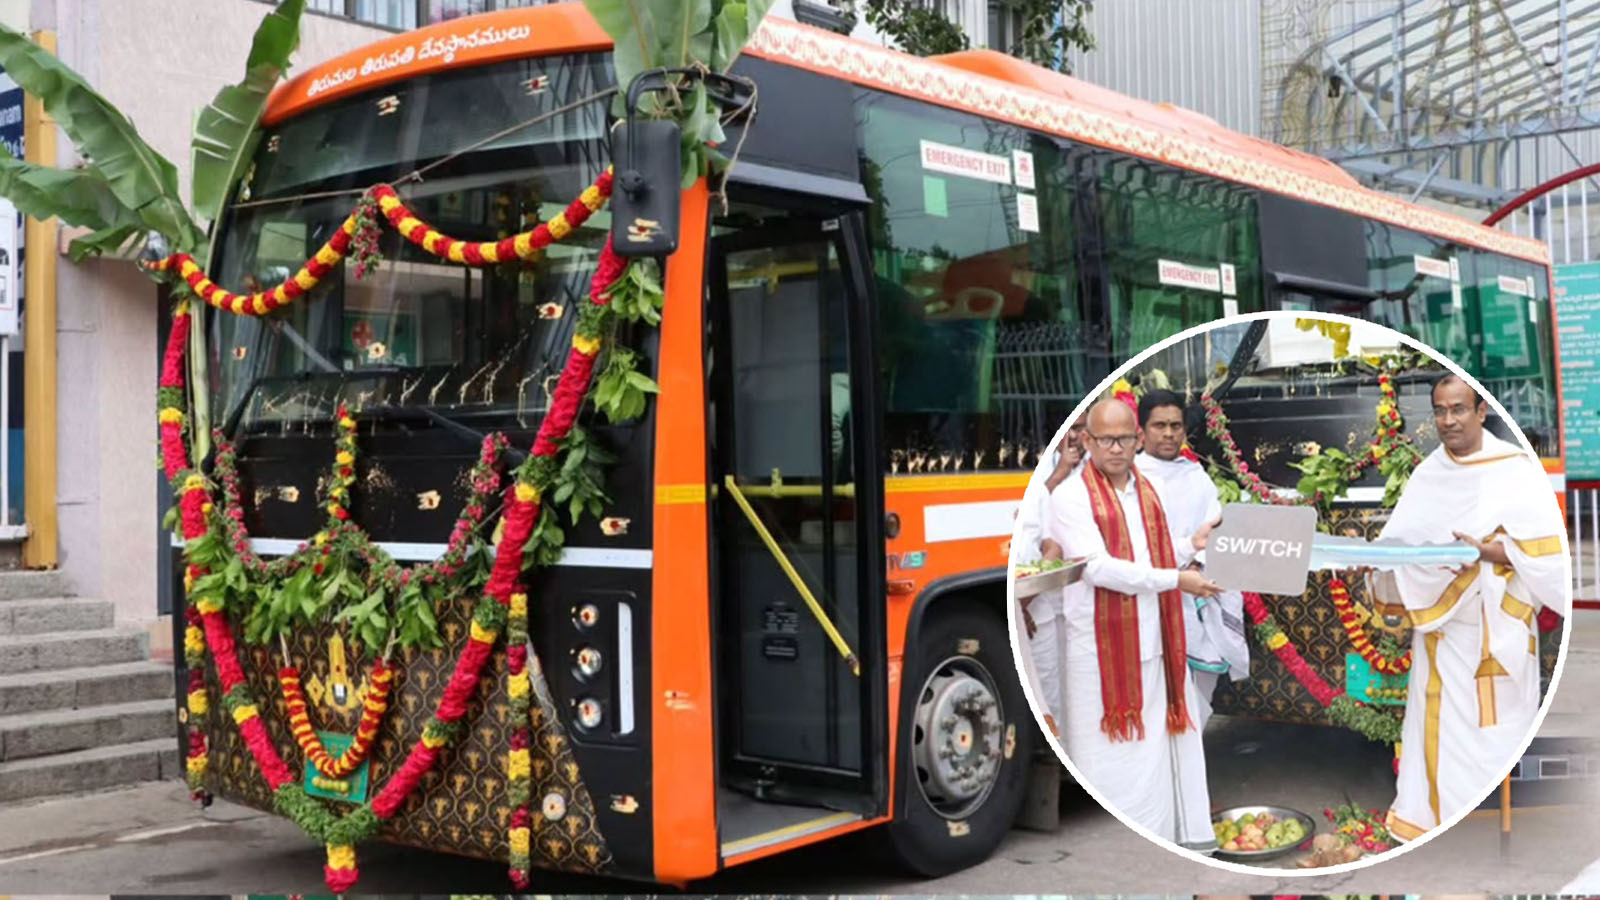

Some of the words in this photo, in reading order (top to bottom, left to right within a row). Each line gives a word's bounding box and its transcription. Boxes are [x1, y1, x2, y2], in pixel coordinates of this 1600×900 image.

[360, 47, 414, 75] తిరుపతి
[925, 147, 983, 171] EMERGENCY
[986, 159, 1006, 177] EXIT
[1162, 265, 1202, 283] EMERGENCY
[1203, 271, 1217, 285] EXIT
[1215, 535, 1303, 559] SWITCH
